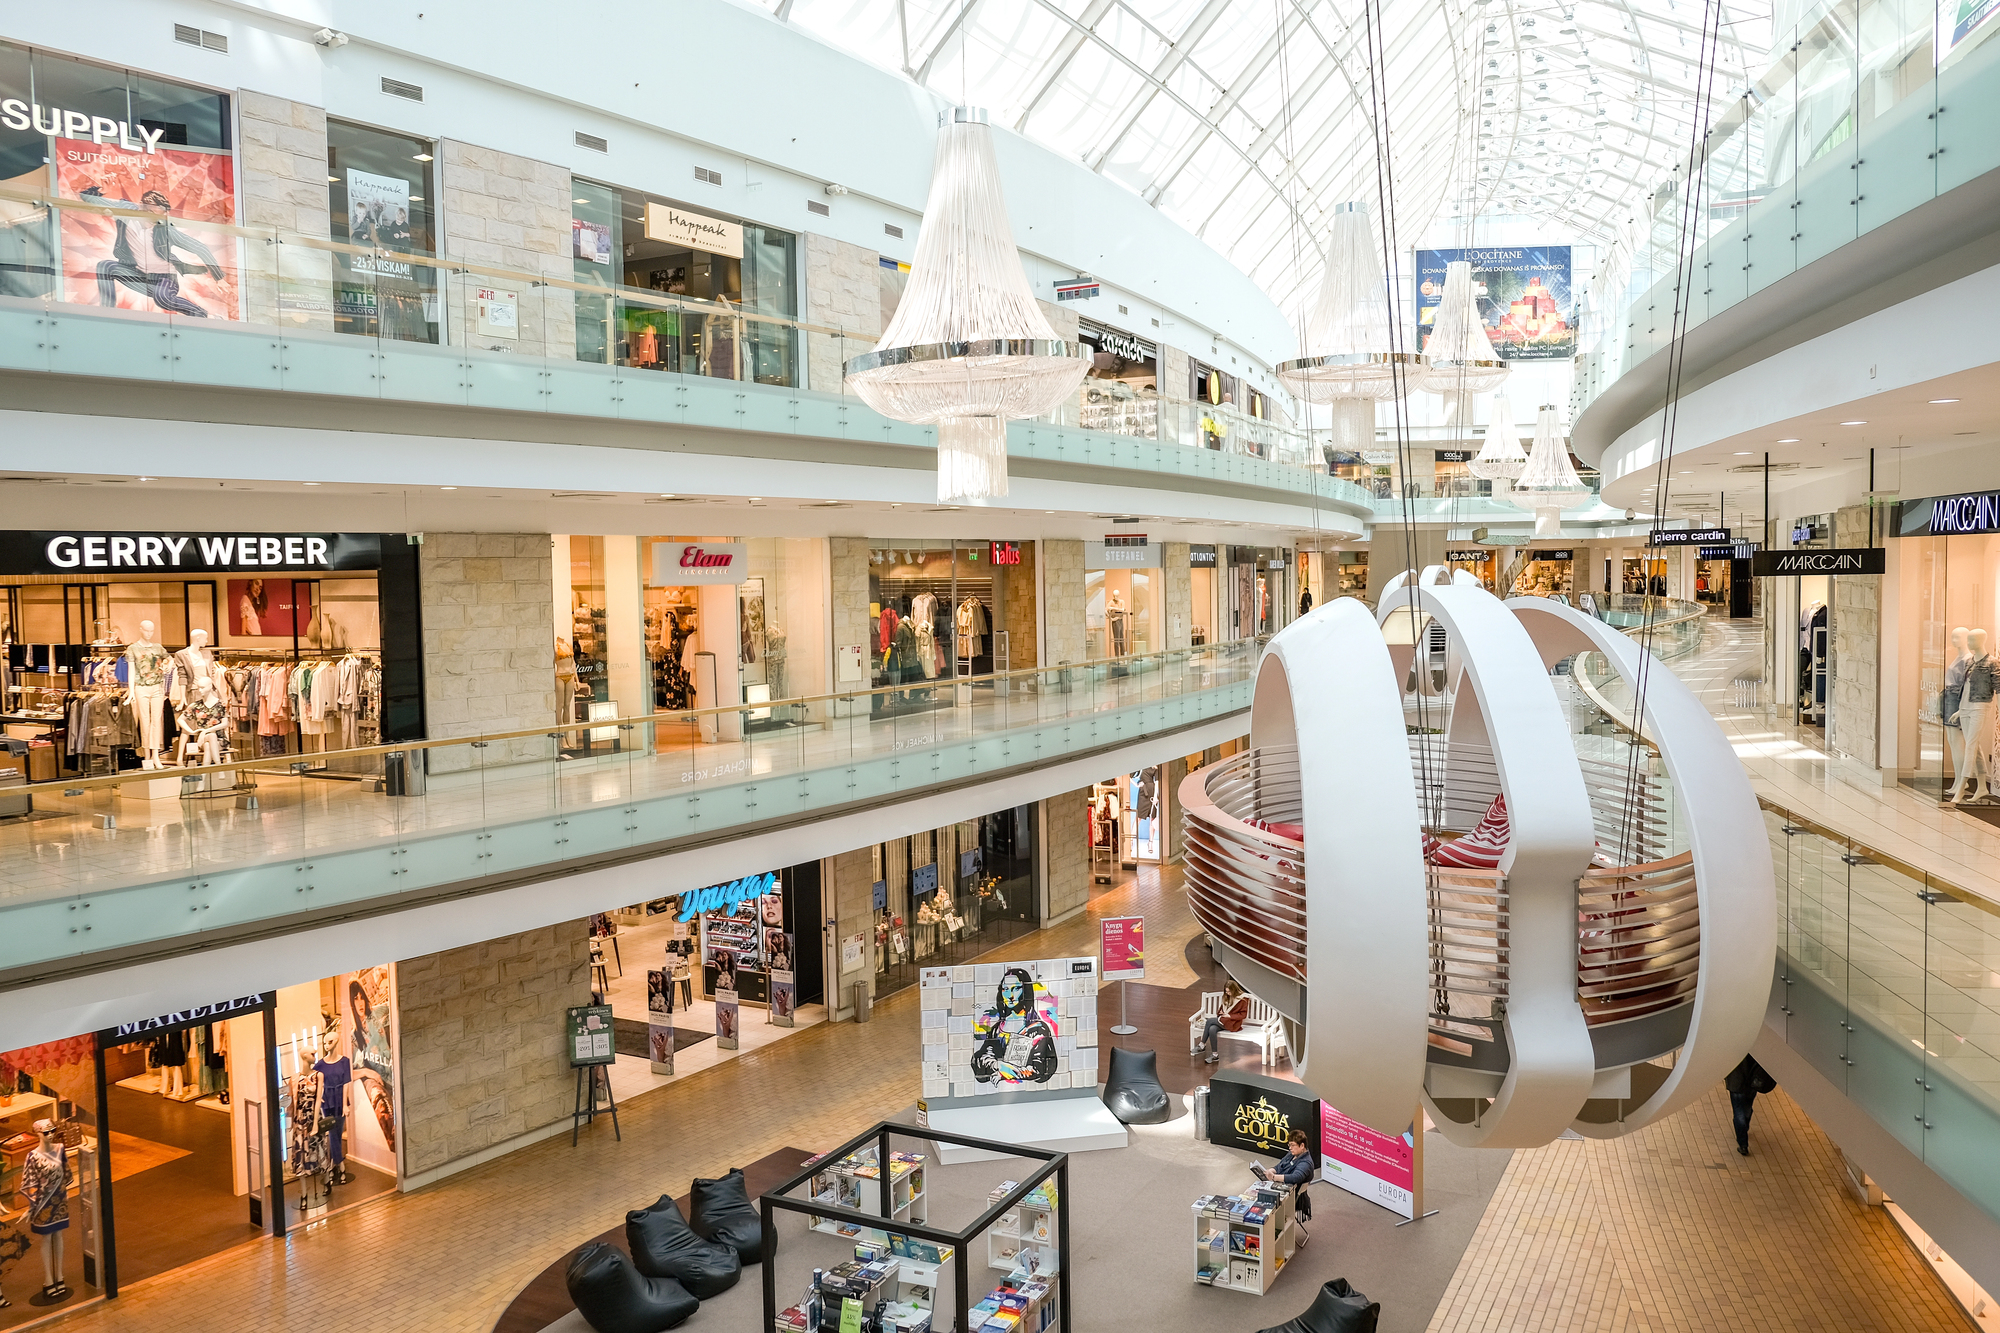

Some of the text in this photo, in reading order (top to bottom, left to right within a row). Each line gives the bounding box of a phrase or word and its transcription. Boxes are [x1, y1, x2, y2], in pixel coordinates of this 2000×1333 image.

[67, 150, 152, 169] SUITSUPPLY
[354, 176, 403, 195] Happeak
[668, 210, 727, 238] Happeak
[376, 260, 411, 276] VISKAM!
[1493, 264, 1524, 273] DOVANAS
[1654, 530, 1726, 544] pierre cardin
[47, 535, 329, 568] GERRY WEBER
[679, 546, 734, 568] Etam
[1105, 550, 1145, 562] STEFANEL
[1450, 552, 1482, 561] GANT
[576, 664, 594, 673] tam
[677, 871, 777, 924] Douglas
[1234, 1116, 1290, 1144] GOLD
[1325, 1122, 1348, 1136] Balandžio
[1378, 1182, 1407, 1203] EUROPA
